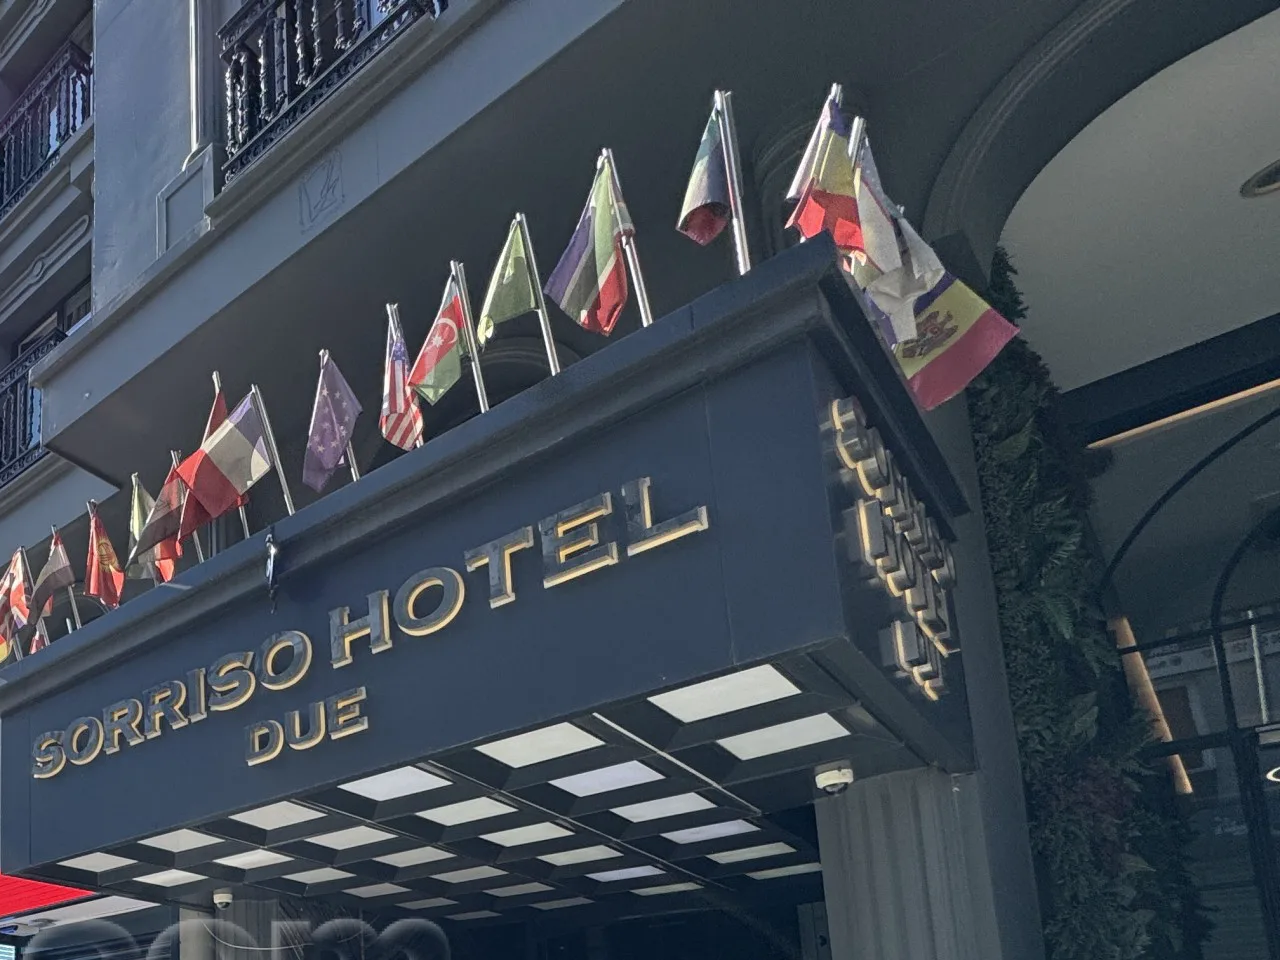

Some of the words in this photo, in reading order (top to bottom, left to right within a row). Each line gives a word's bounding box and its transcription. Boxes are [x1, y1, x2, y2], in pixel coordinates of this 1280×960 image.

[30, 629, 313, 779] SORRISO
[329, 476, 710, 669] HOTEL
[245, 686, 369, 766] DUE
